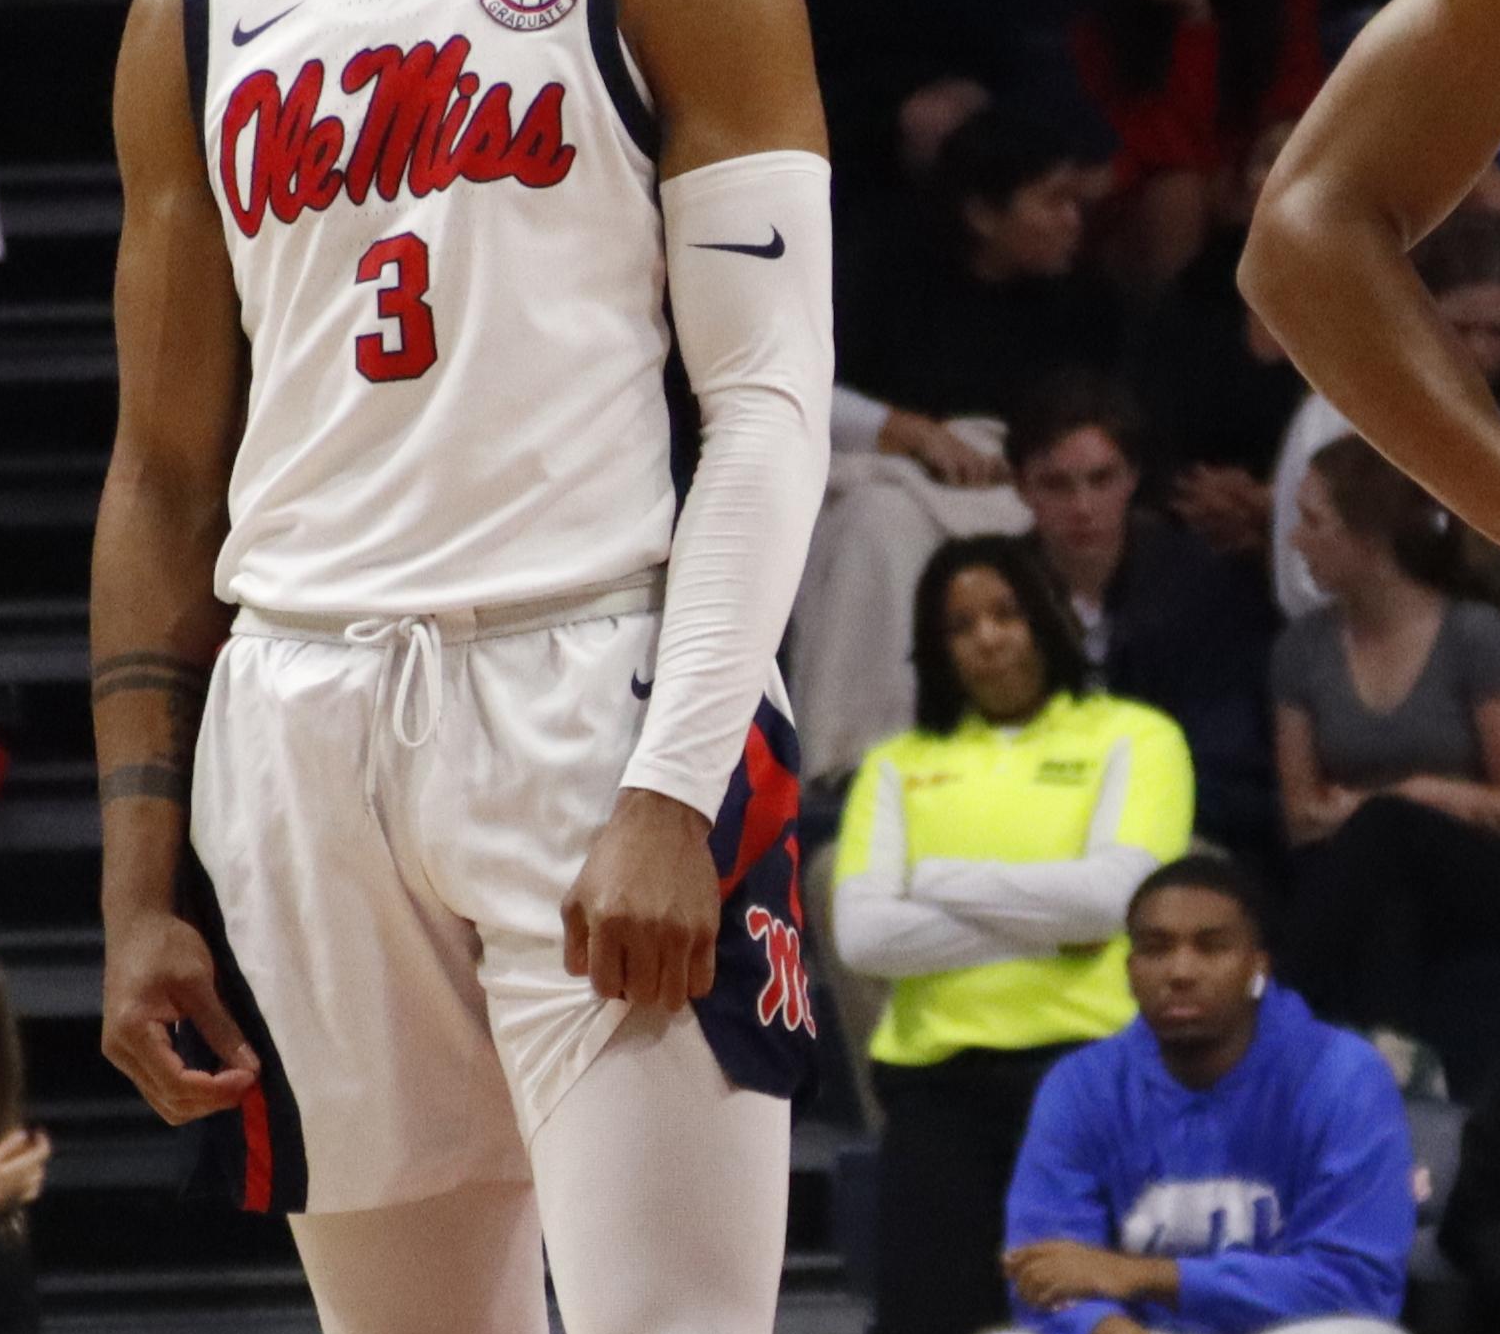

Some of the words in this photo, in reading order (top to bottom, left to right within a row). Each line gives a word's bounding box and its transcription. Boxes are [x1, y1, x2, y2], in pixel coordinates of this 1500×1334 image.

[488, 0, 564, 28] GRADUATE
[220, 59, 345, 239] Ole
[340, 34, 576, 205] Miss
[355, 231, 438, 383] 3
